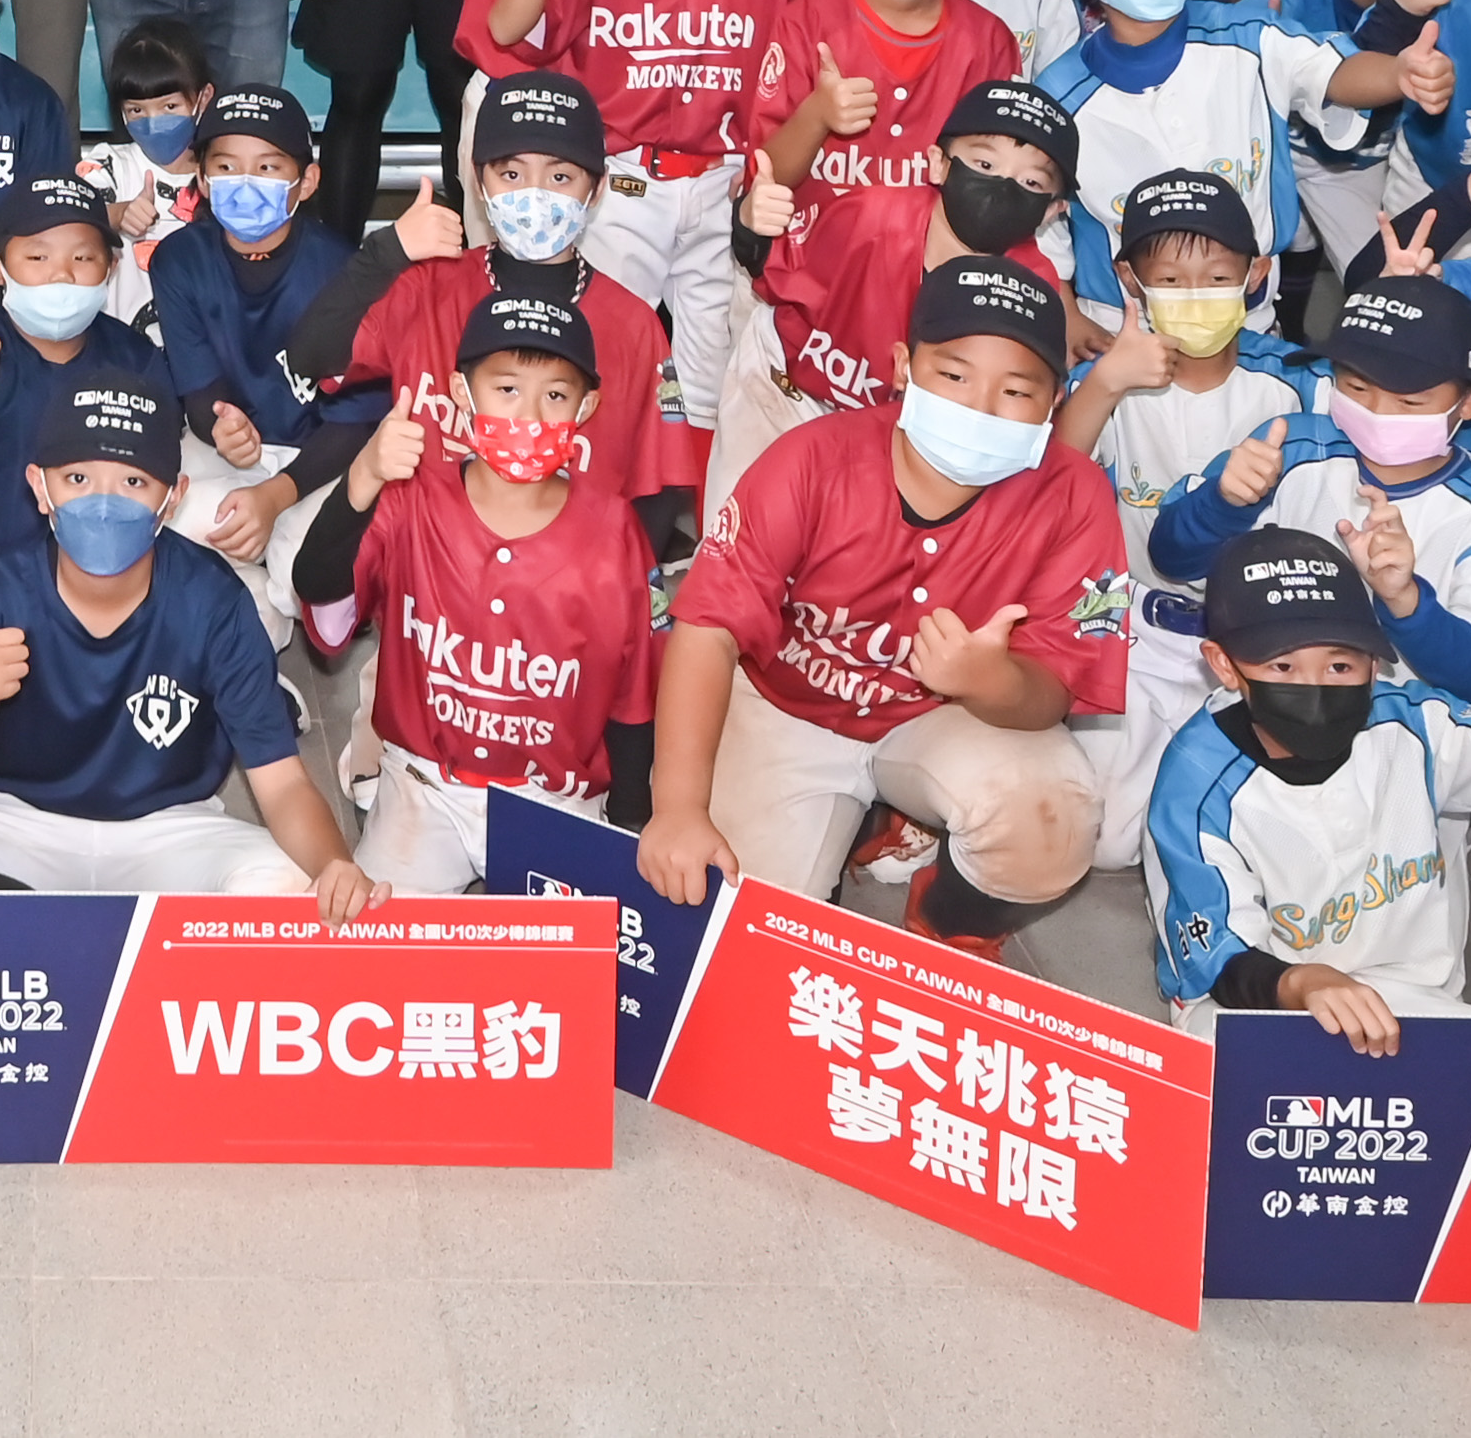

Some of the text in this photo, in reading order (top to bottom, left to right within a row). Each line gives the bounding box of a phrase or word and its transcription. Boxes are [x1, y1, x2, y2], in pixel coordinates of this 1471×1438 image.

[1268, 558, 1341, 581] MLB CUP
[426, 693, 554, 747] ONKEYS
[764, 911, 809, 943] 2022
[811, 927, 855, 958] MLB
[856, 940, 899, 973] CUP
[901, 961, 983, 1002] TAIWAN
[160, 999, 561, 1081] WBC黑豹
[787, 965, 1130, 1165] 樂天桃猿
[1326, 1095, 1414, 1129] MLB
[825, 1062, 1079, 1231] 夢無限
[1246, 1127, 1428, 1163] CUP 2022
[1297, 1167, 1376, 1185] TAIWAN
[1296, 1192, 1409, 1217] 華南金控
